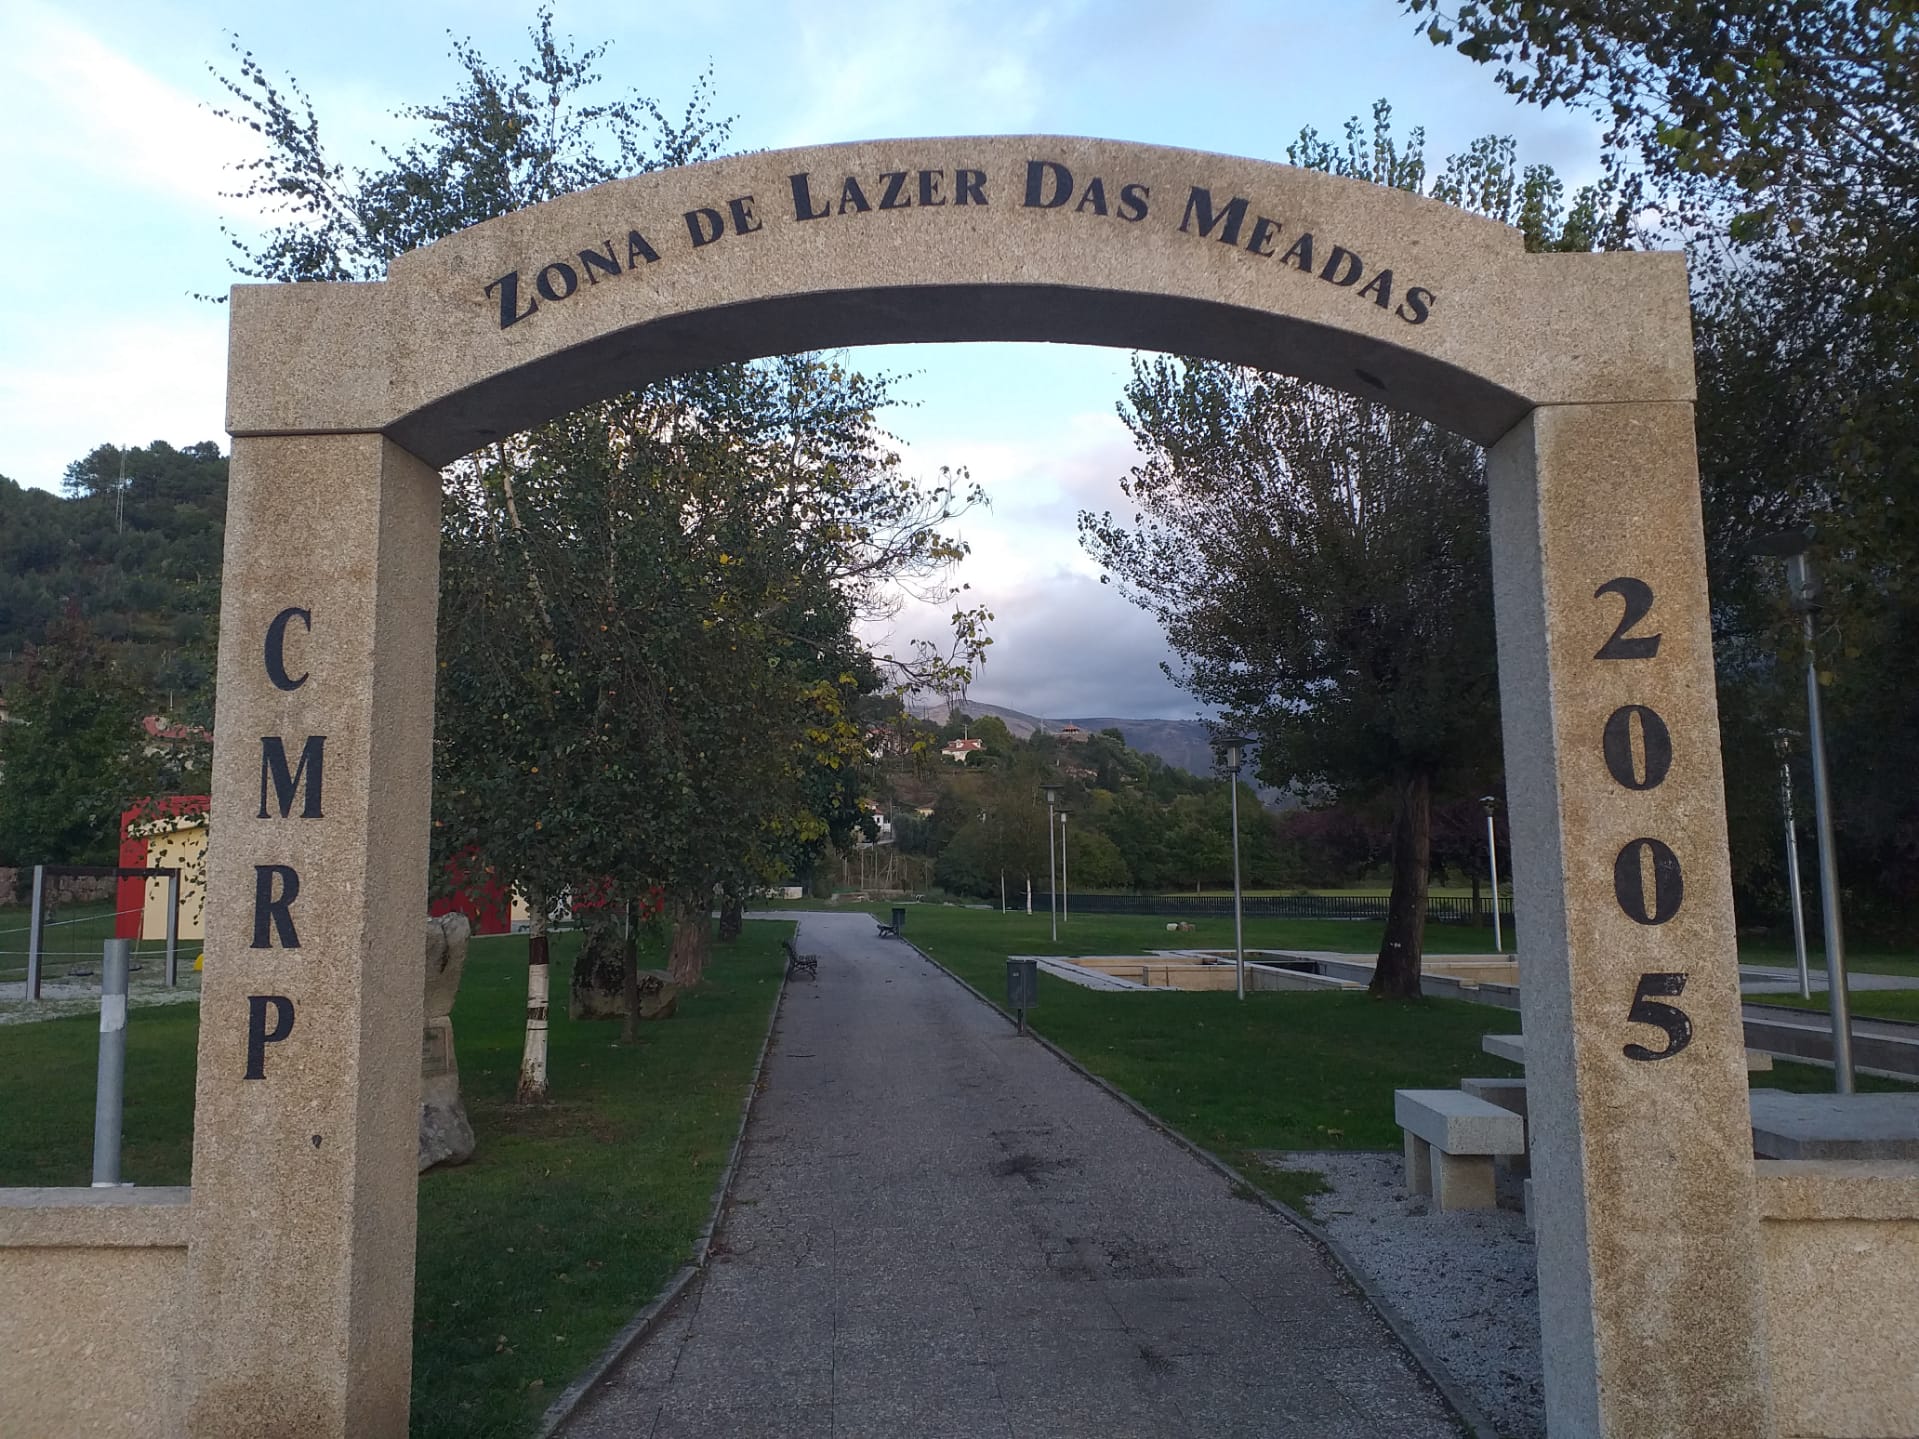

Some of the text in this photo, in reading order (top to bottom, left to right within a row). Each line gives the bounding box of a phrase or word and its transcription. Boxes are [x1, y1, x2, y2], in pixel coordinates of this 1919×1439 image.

[484, 160, 1435, 331] ZONA DE LAZER DAS MEADAS
[1593, 576, 1693, 1062] 2005
